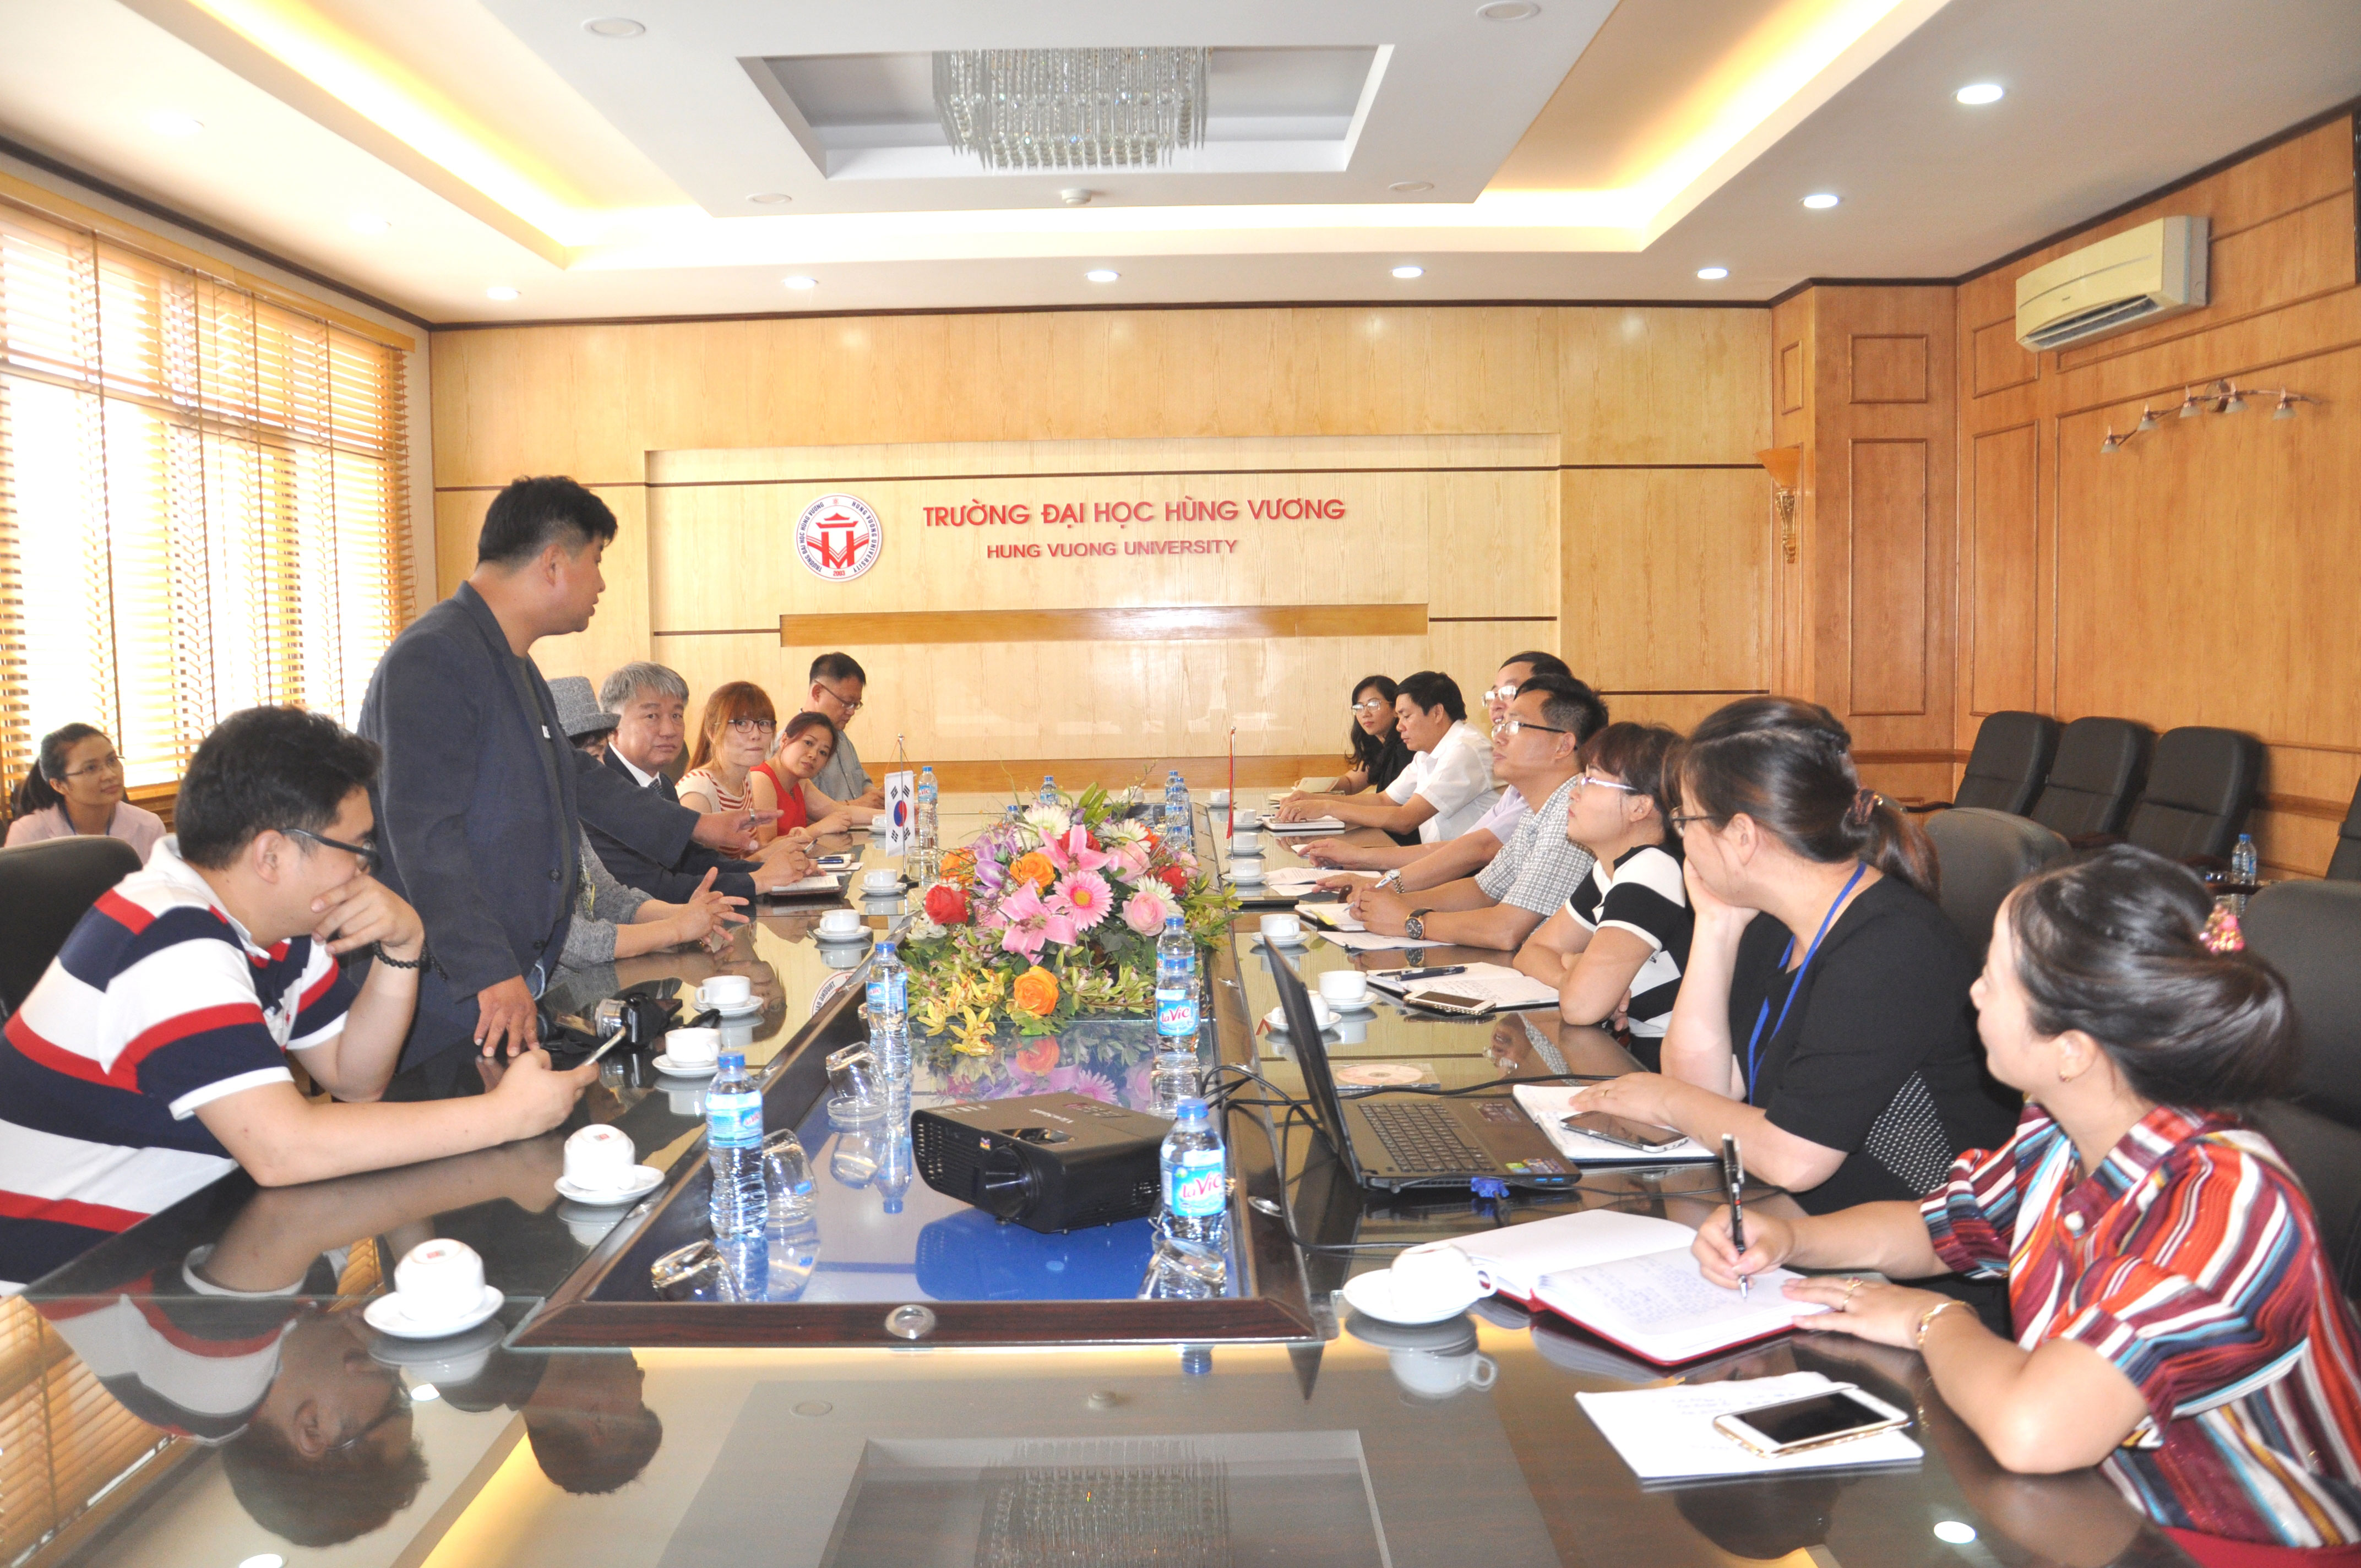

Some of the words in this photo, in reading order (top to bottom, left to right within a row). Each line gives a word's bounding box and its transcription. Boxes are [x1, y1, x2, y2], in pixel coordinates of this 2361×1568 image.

[923, 498, 1030, 527] TRƯỜNG
[1041, 503, 1084, 529] ĐẠI
[1094, 501, 1154, 529] HỌC
[1165, 495, 1239, 521] HÙNG
[1247, 498, 1346, 520] VƯƠNG
[853, 539, 877, 573] UNIVERSITY
[987, 543, 1041, 558] HUNG
[1047, 542, 1117, 557] VUONG
[1124, 540, 1237, 556] UNIVERSITY
